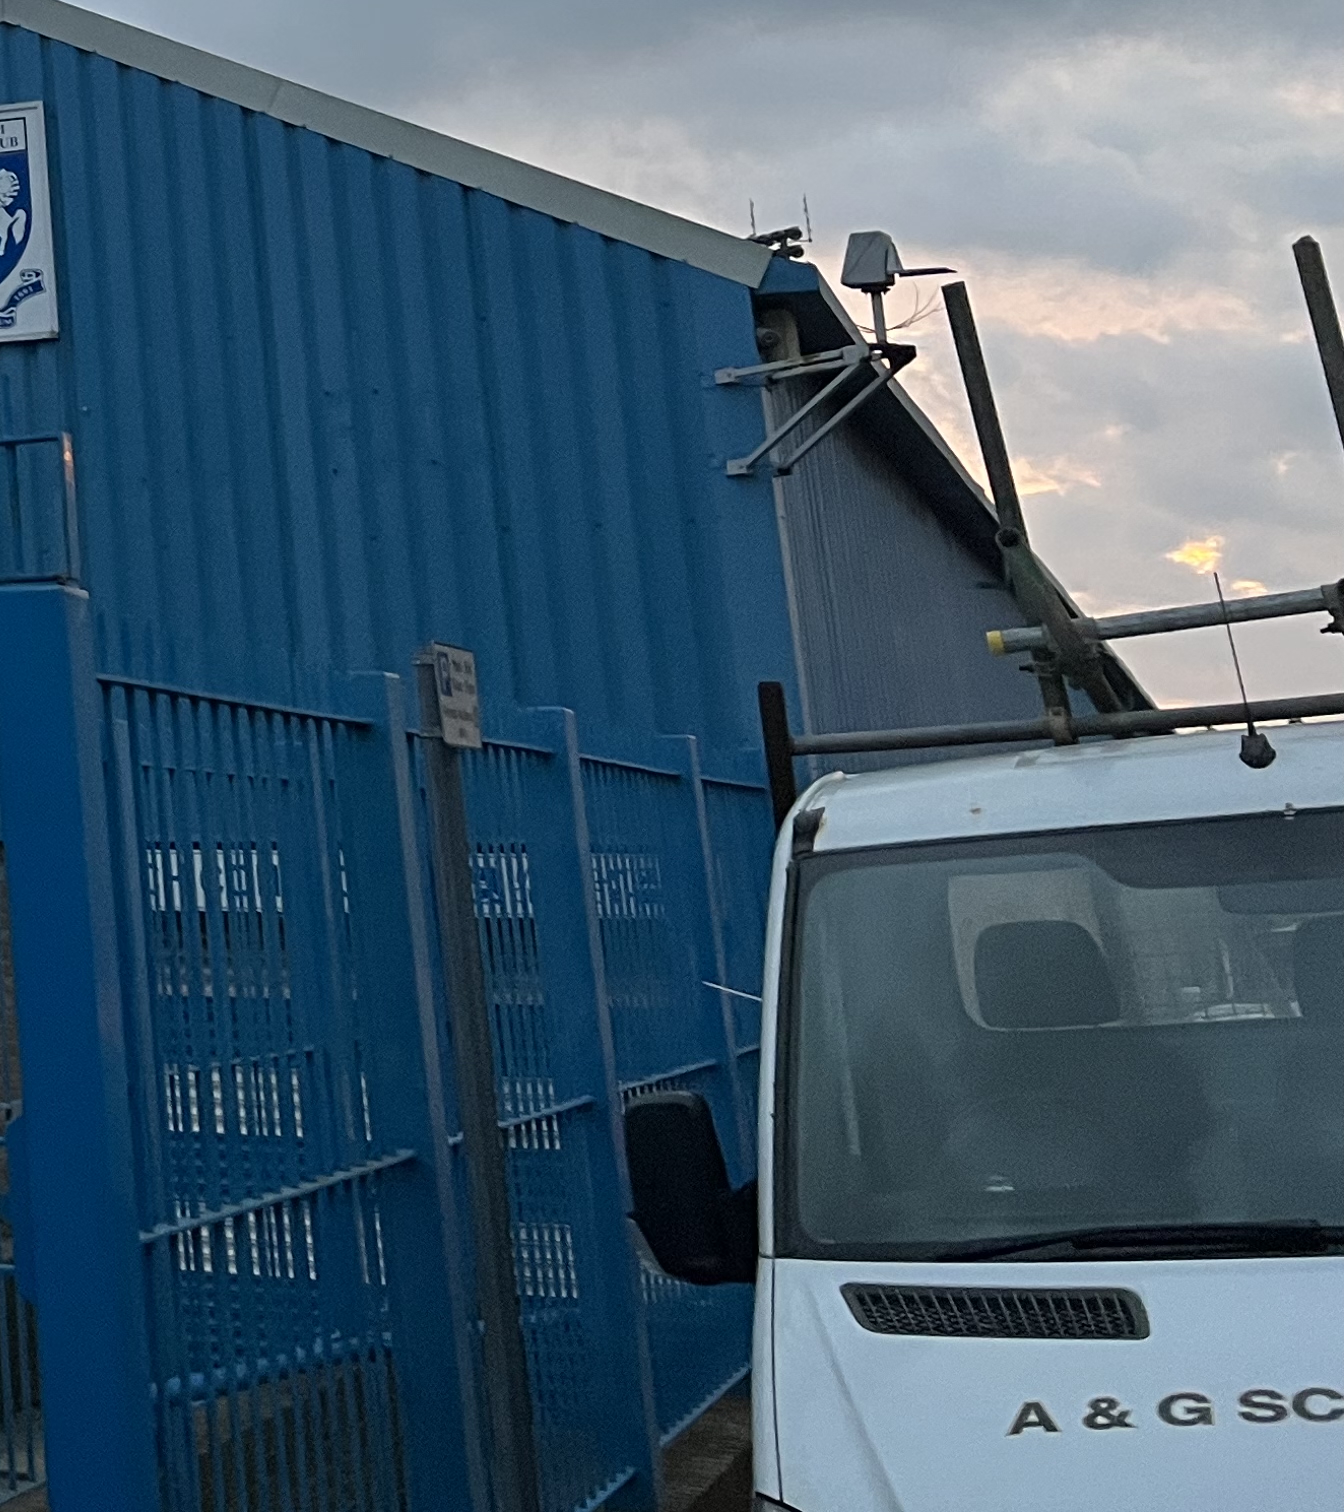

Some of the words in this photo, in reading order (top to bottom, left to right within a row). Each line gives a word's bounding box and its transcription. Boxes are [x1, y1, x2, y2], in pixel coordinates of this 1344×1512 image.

[1006, 1401, 1061, 1436] A
[1083, 1395, 1137, 1430] &
[1157, 1392, 1214, 1427] G
[1237, 1387, 1344, 1424] SC
